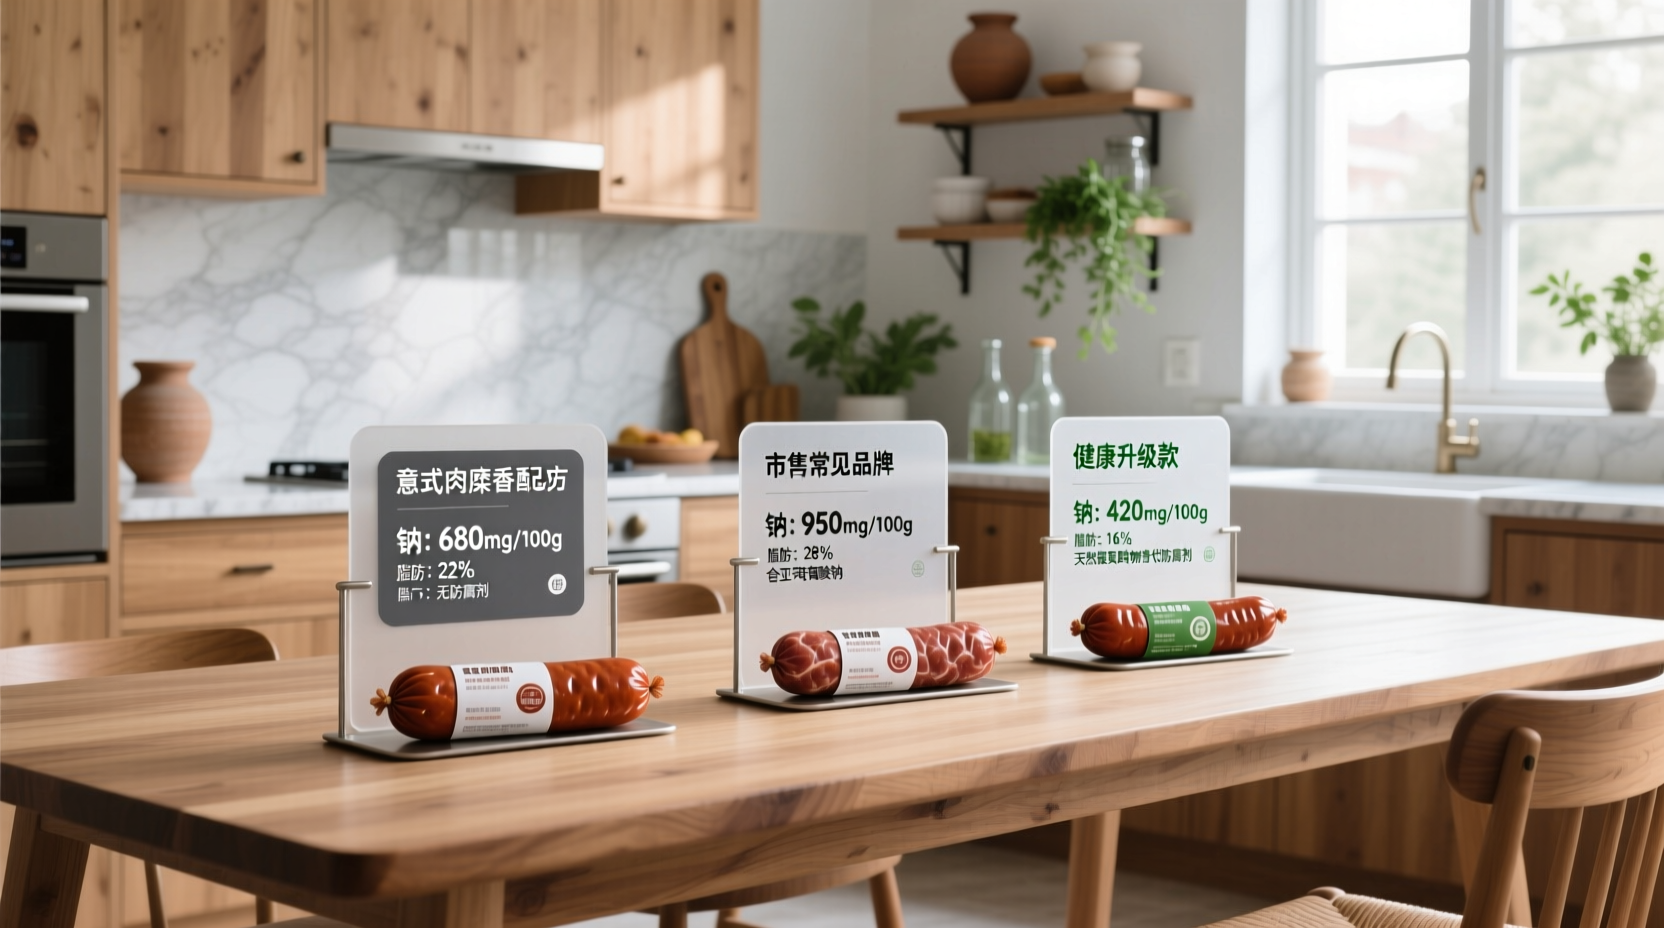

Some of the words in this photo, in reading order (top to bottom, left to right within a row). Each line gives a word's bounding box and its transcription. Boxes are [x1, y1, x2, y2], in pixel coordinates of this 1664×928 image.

[765, 450, 894, 478] 市售常见品牌
[1073, 441, 1179, 469] 健康升级款
[801, 510, 913, 538] 950mg/100g
[1107, 499, 1208, 525] 420mg/100g
[438, 525, 563, 554] 680mg/100g
[438, 560, 475, 580] 22%
